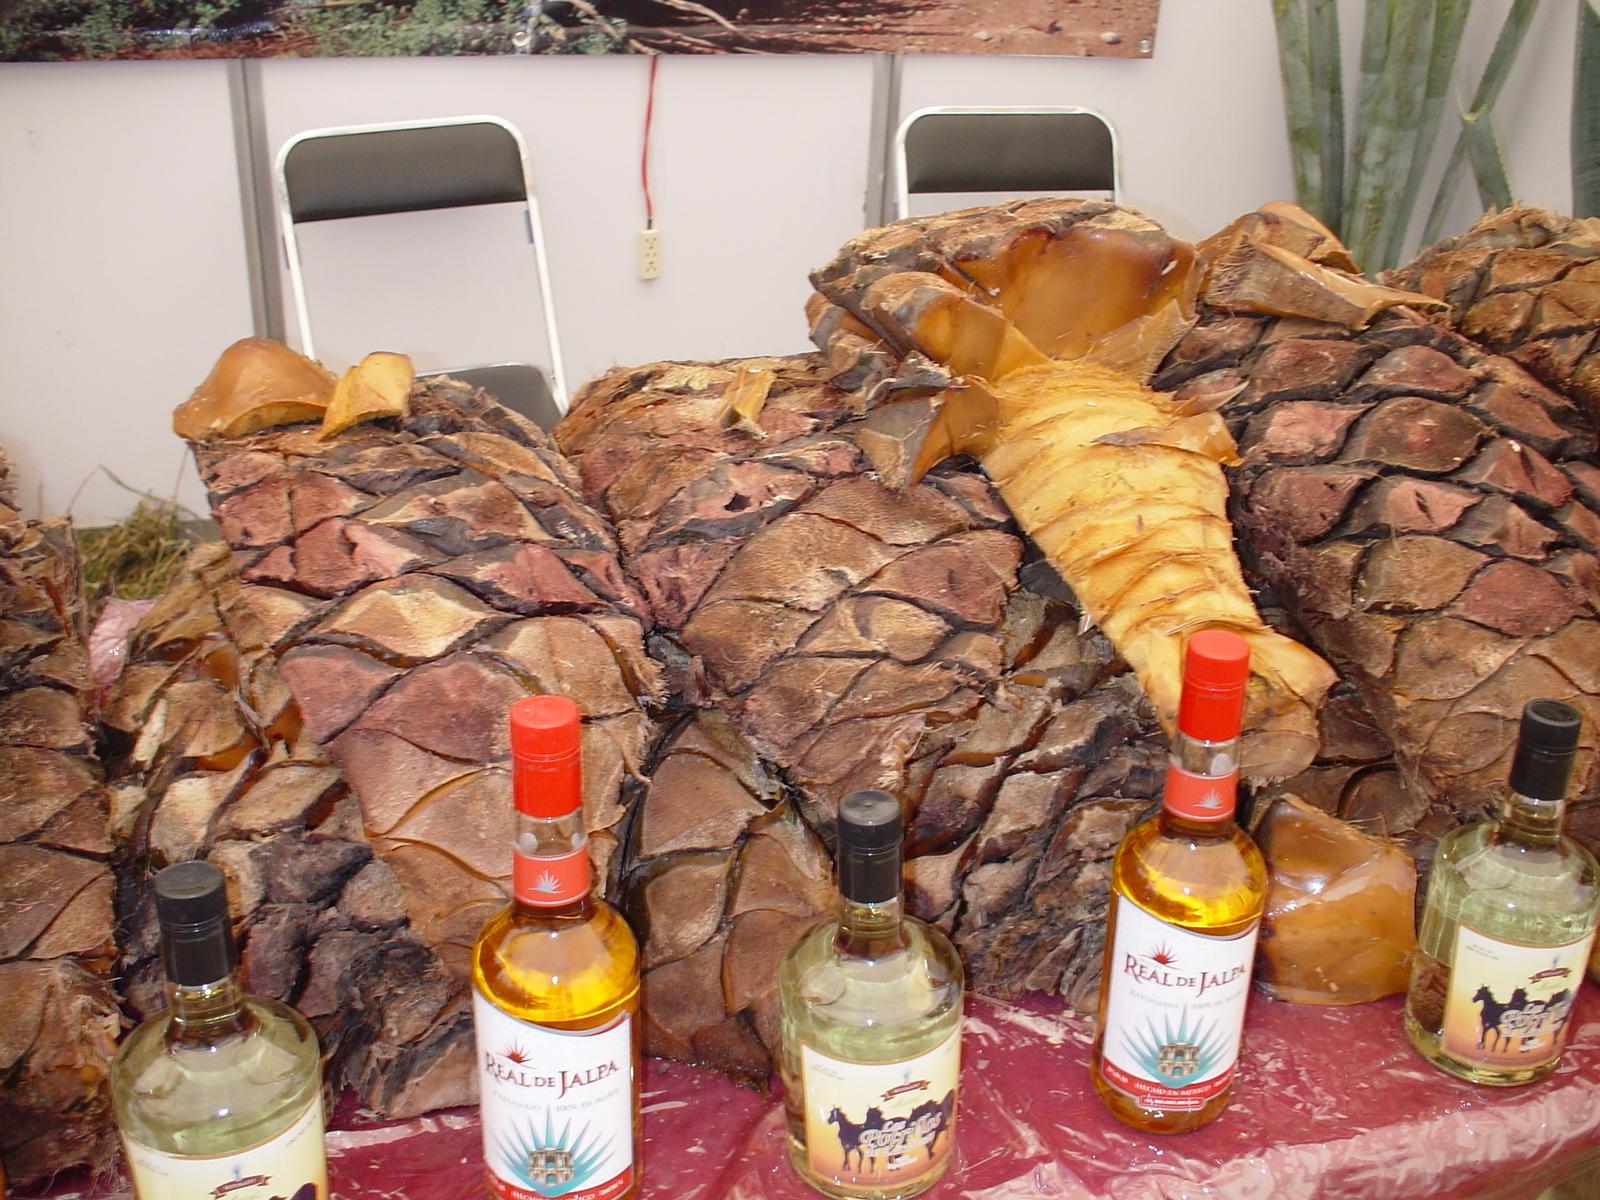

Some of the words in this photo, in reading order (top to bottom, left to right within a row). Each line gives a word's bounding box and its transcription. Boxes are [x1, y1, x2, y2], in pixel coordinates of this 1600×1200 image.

[1124, 953, 1172, 987] REAL
[1176, 977, 1196, 988] DE
[1196, 964, 1246, 998] JALPA
[485, 1051, 531, 1087] REAL
[534, 1076, 556, 1088] DE
[557, 1059, 620, 1099] JALPA
[858, 1112, 943, 1147] Potrillos
